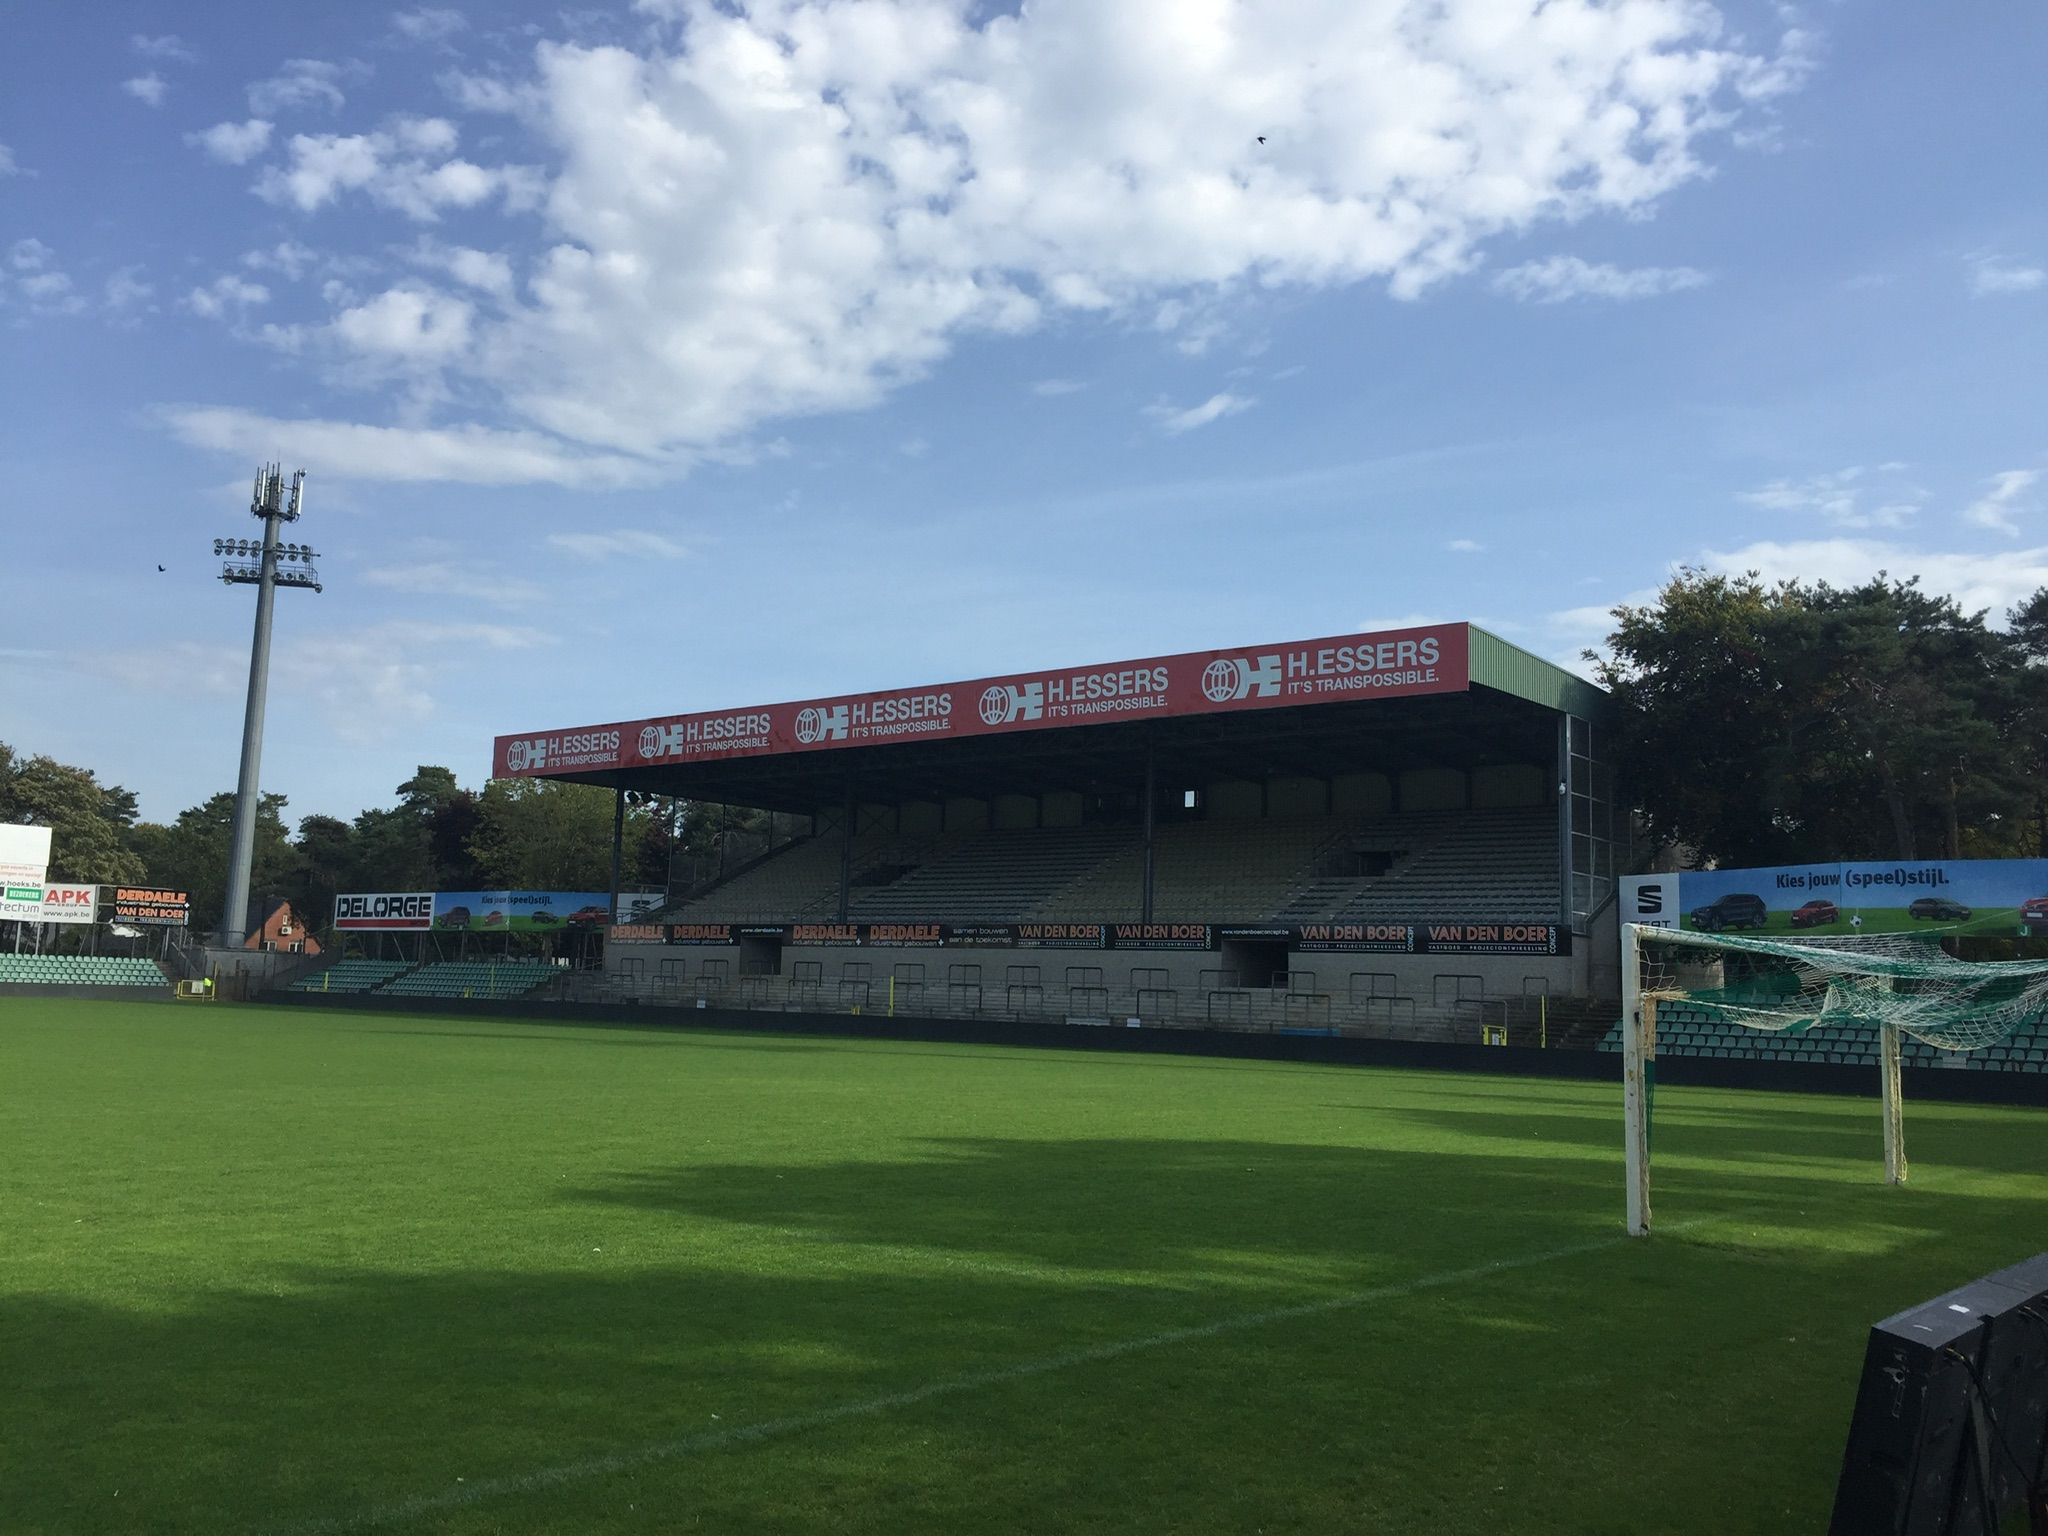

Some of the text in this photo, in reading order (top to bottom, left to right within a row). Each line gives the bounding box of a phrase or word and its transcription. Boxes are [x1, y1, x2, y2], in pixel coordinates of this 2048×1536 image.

[1288, 637, 1440, 677] H.ESSERS
[1048, 666, 1168, 702] H.ESSERS
[1288, 668, 1439, 694] IT'S TRANSPOSSIBLE.
[852, 693, 952, 724] H.ESSERS
[1048, 694, 1168, 717] IT'S TRANSPOSSIBLE.
[687, 713, 770, 741] H.ESSERS
[852, 717, 951, 738] IT'S TRANSPOSSIBLE.
[549, 730, 620, 755] H.ESSERS
[687, 736, 770, 754] IT'S TRANSPOSSIBLE.
[548, 751, 619, 767] IT'S TRANSPOSSIBLE.
[1776, 868, 1950, 891] Kies jouw (speel)stijl.
[45, 889, 91, 904] APK
[117, 889, 187, 904] DERDAELE
[116, 907, 137, 916] VAN
[139, 908, 158, 917] DEN
[160, 909, 184, 918] BOER
[336, 896, 432, 917] DELORGE
[610, 925, 664, 939] DERDAELE
[673, 925, 731, 939] DERDAELE
[793, 925, 858, 940] DERDAELE
[869, 925, 941, 940] DERDAELE
[1018, 925, 1100, 939] VAN DEN BOER
[1115, 925, 1205, 939] VAN DEN BOER
[1300, 925, 1406, 941] VAN DEN BOER
[1428, 926, 1547, 942] VAN DEN BOER
[2020, 925, 2028, 936] J
[904, 940, 937, 948] gebouwen
[1549, 926, 1557, 954] CONCEPT
